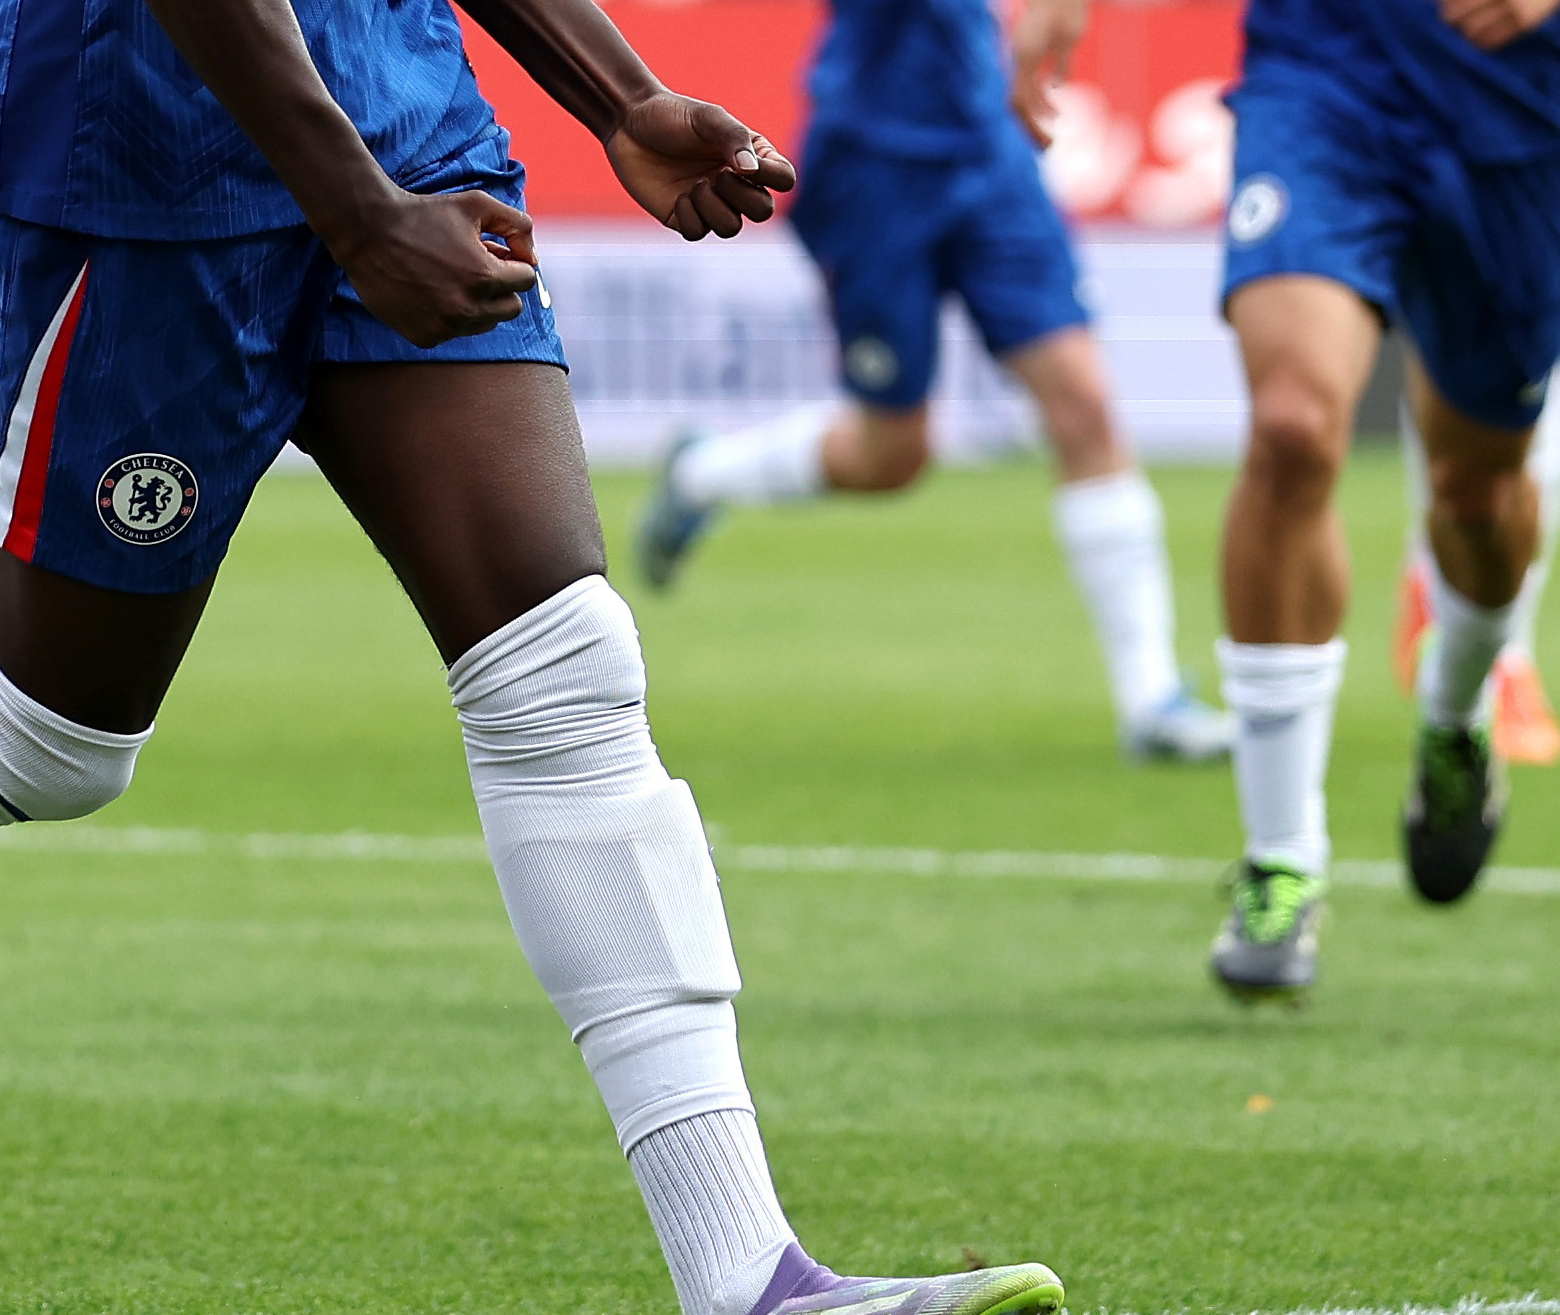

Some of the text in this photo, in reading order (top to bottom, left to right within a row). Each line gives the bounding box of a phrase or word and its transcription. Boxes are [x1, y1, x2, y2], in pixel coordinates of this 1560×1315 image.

[121, 457, 185, 480] CHELSEA
[109, 518, 176, 541] FOOTBALL CLUB
